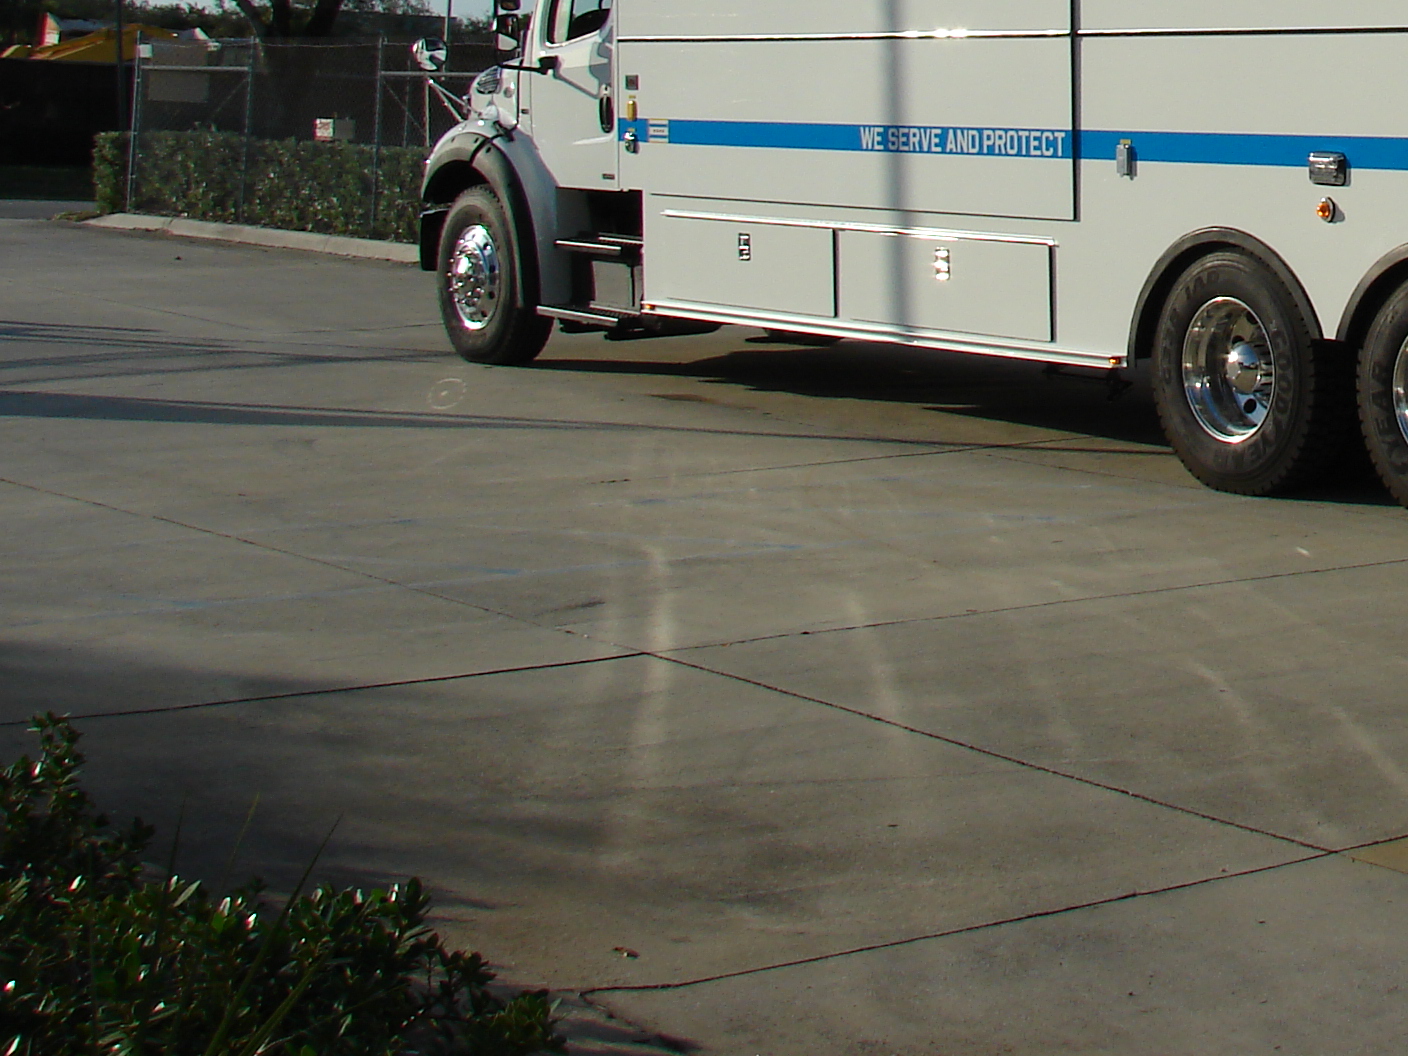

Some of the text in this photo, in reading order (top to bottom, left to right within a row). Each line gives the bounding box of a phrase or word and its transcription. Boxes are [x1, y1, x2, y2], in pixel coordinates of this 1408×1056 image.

[859, 126, 1066, 157] WE SERVE AND PROTECT
[1213, 329, 1293, 474] GOODYEAR
